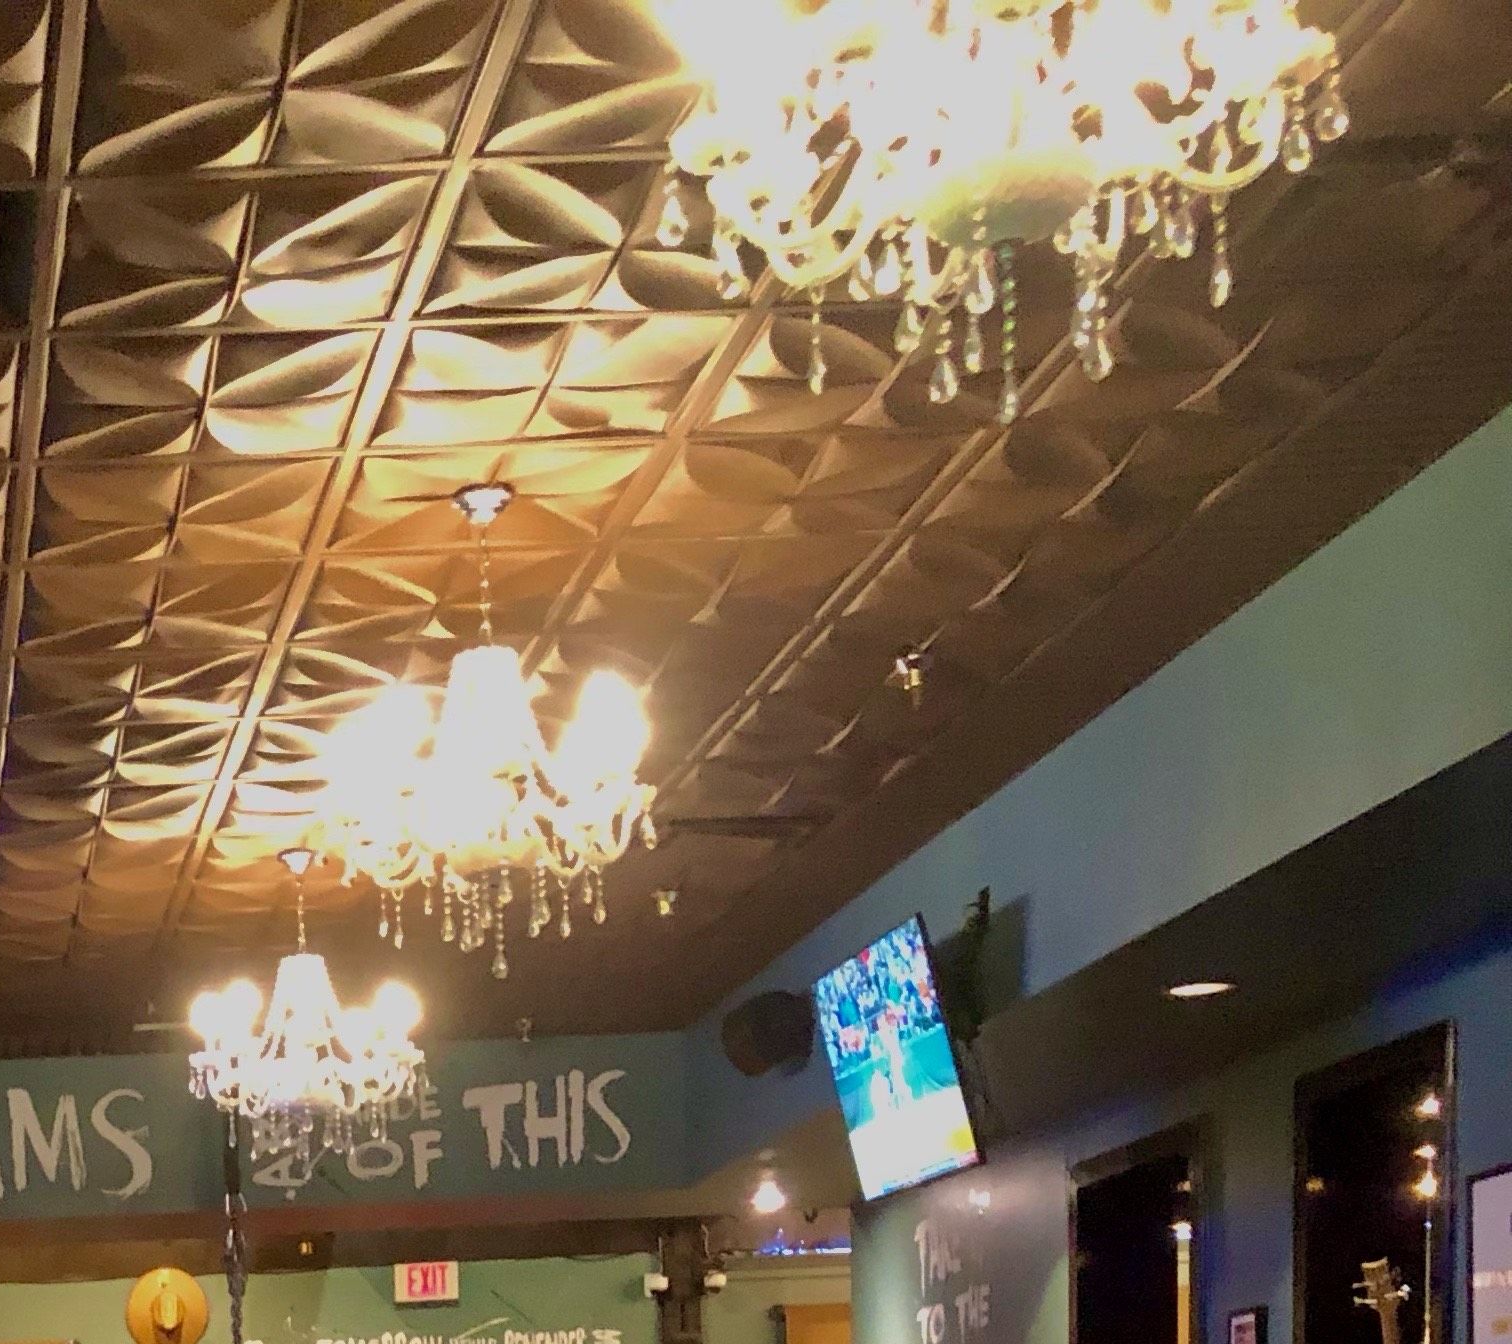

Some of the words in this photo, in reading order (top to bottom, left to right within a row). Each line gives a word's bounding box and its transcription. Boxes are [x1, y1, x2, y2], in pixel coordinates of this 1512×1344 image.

[347, 1129, 444, 1190] OF
[463, 1069, 631, 1169] THIS
[407, 1263, 448, 1298] EXIT
